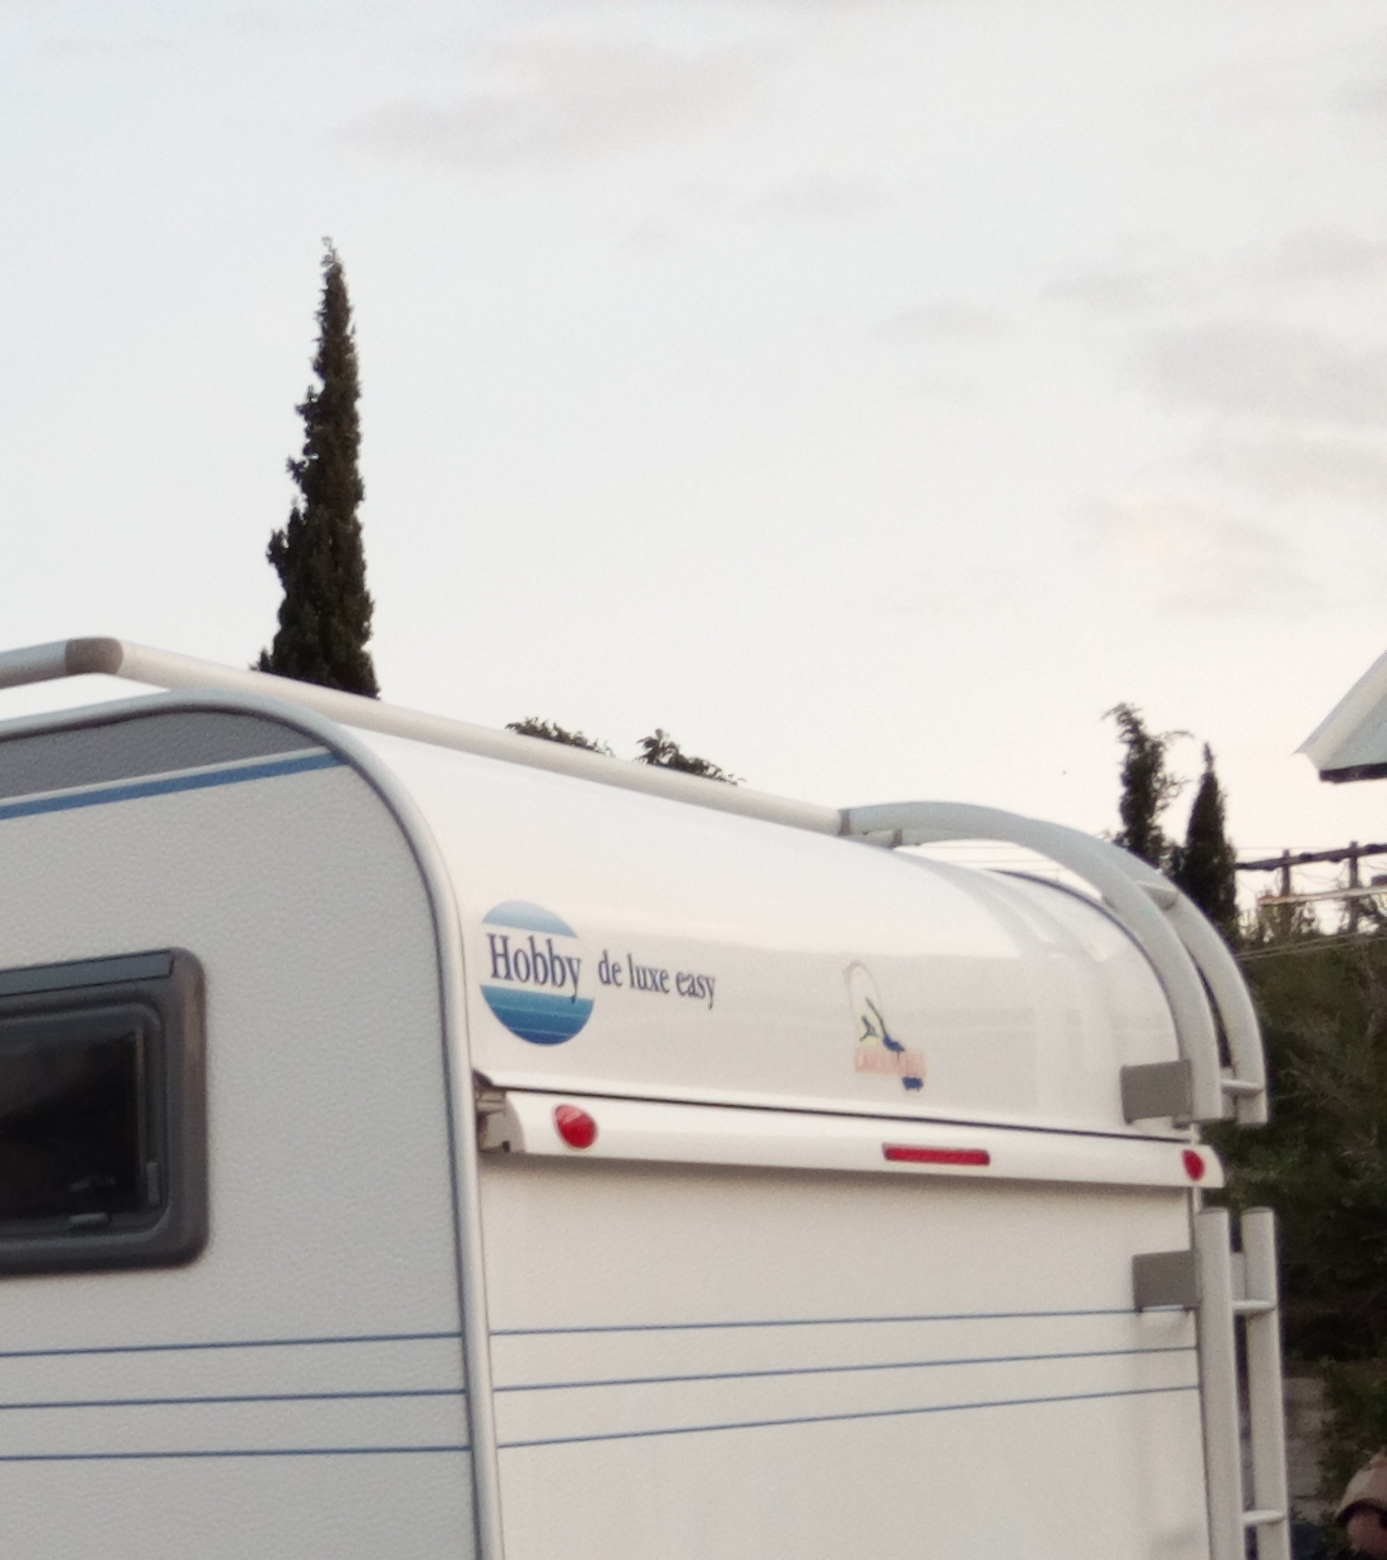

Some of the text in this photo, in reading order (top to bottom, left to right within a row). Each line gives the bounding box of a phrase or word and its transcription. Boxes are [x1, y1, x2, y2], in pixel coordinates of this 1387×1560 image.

[486, 932, 716, 1010] Hobby de luxe easy
